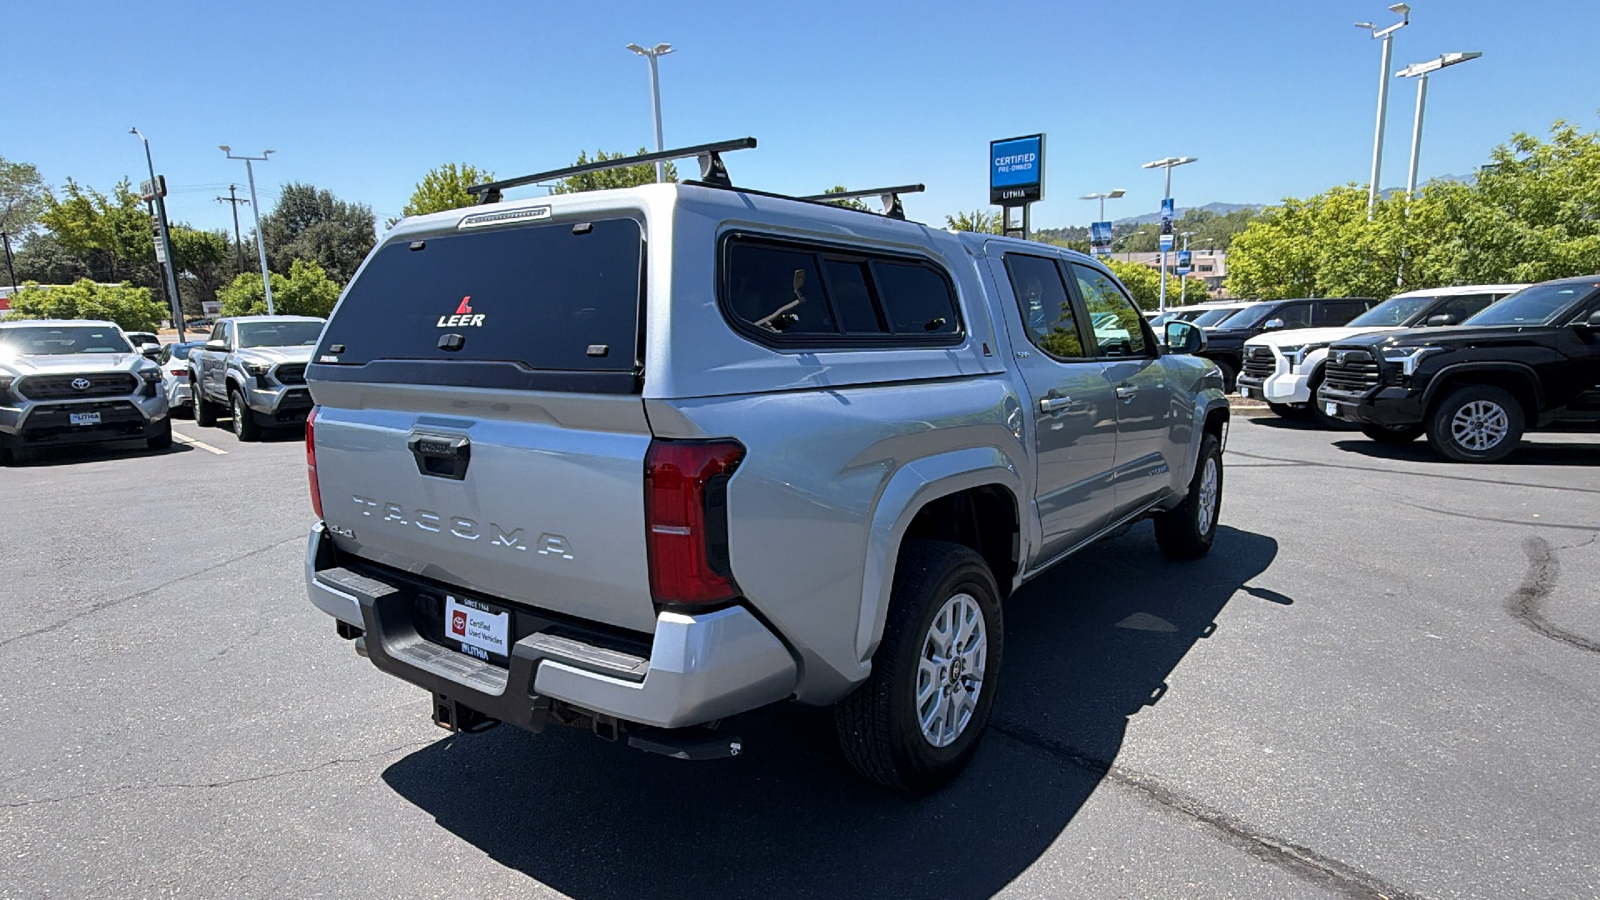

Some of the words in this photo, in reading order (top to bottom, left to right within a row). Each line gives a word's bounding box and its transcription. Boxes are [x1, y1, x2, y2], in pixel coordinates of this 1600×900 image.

[995, 153, 1035, 166] CERTIFIED
[998, 163, 1032, 173] PRE-OWNED
[1003, 190, 1025, 199] LITHIA
[436, 314, 486, 328] LEER
[353, 495, 573, 560] TACOMA
[464, 598, 477, 609] SINCE
[469, 618, 490, 631] Certified
[468, 628, 481, 638] Used
[481, 632, 503, 645] Vehicles
[467, 645, 489, 660] LITHIA
